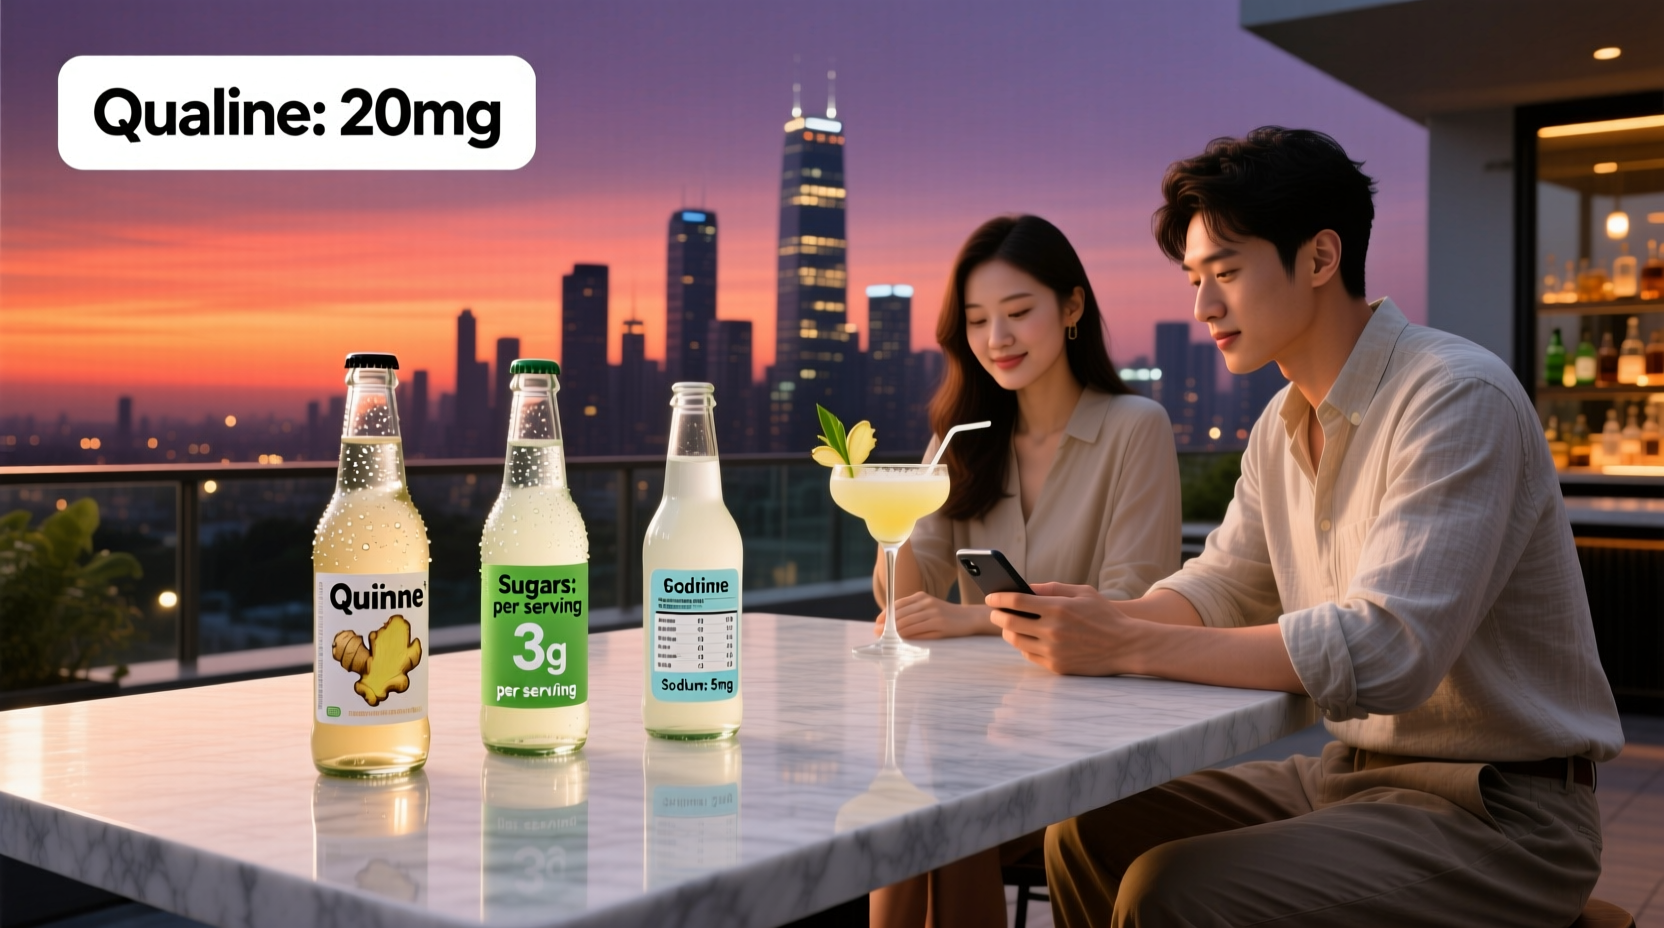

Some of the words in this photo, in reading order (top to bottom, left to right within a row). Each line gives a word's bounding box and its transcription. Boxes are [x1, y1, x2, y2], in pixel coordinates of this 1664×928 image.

[499, 574, 576, 600] Sugars:
[493, 601, 519, 618] per
[524, 597, 582, 617] serving
[512, 622, 567, 676] 3g
[496, 685, 520, 702] per
[710, 678, 734, 694] 5mg
